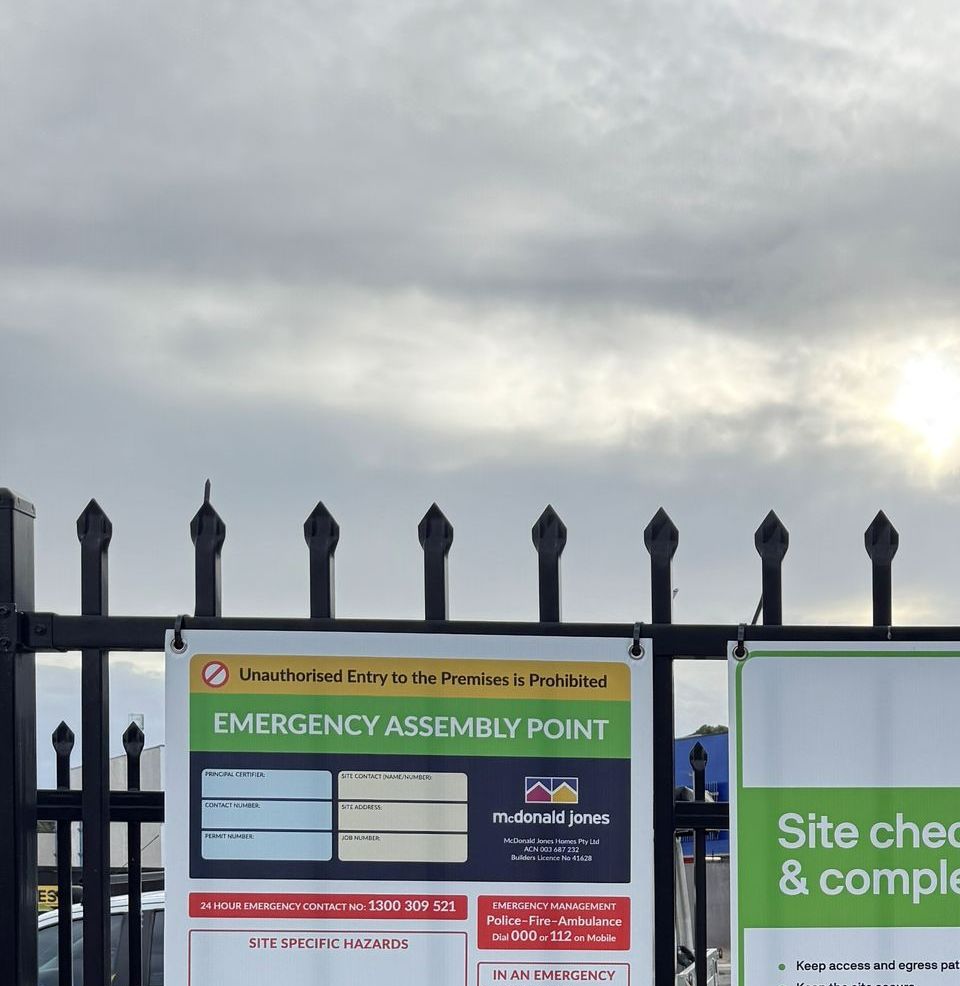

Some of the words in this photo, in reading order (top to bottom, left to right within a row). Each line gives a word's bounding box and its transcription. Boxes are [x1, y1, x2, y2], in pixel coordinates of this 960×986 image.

[239, 667, 342, 682] Unauthorised
[347, 669, 388, 686] Entry
[391, 671, 407, 684] to
[411, 670, 436, 684] the
[441, 671, 509, 686] Premises
[513, 672, 525, 686] is
[529, 673, 607, 688] Prohibited
[214, 712, 380, 735] EMERGENCY
[384, 715, 521, 738] ASSEMBLY
[527, 718, 609, 740] POINT
[567, 810, 609, 827] jones
[778, 812, 859, 849] Site
[779, 859, 809, 895] &
[200, 901, 211, 910] 24
[213, 901, 241, 910] HOUR
[243, 902, 301, 910] EMERGENCY
[302, 902, 347, 910] CONTACT
[368, 899, 401, 911] 1300
[404, 899, 429, 911] 309
[433, 900, 456, 911] 521
[492, 901, 549, 910] EMERGENCY
[550, 902, 616, 910] MANAGEMENT
[492, 932, 509, 941] Dial
[510, 929, 537, 941] 000
[550, 930, 571, 941] 112
[586, 933, 616, 942] Mobile
[249, 937, 277, 948] SITE
[280, 938, 339, 949] SPECIFIC
[343, 938, 408, 949] HAZARDS
[796, 960, 826, 972] Keep
[828, 962, 870, 970] access
[873, 959, 895, 970] and
[898, 962, 937, 972] egress
[493, 969, 506, 980] IN
[510, 969, 529, 980] AN
[534, 970, 615, 980] EMERGENCY
